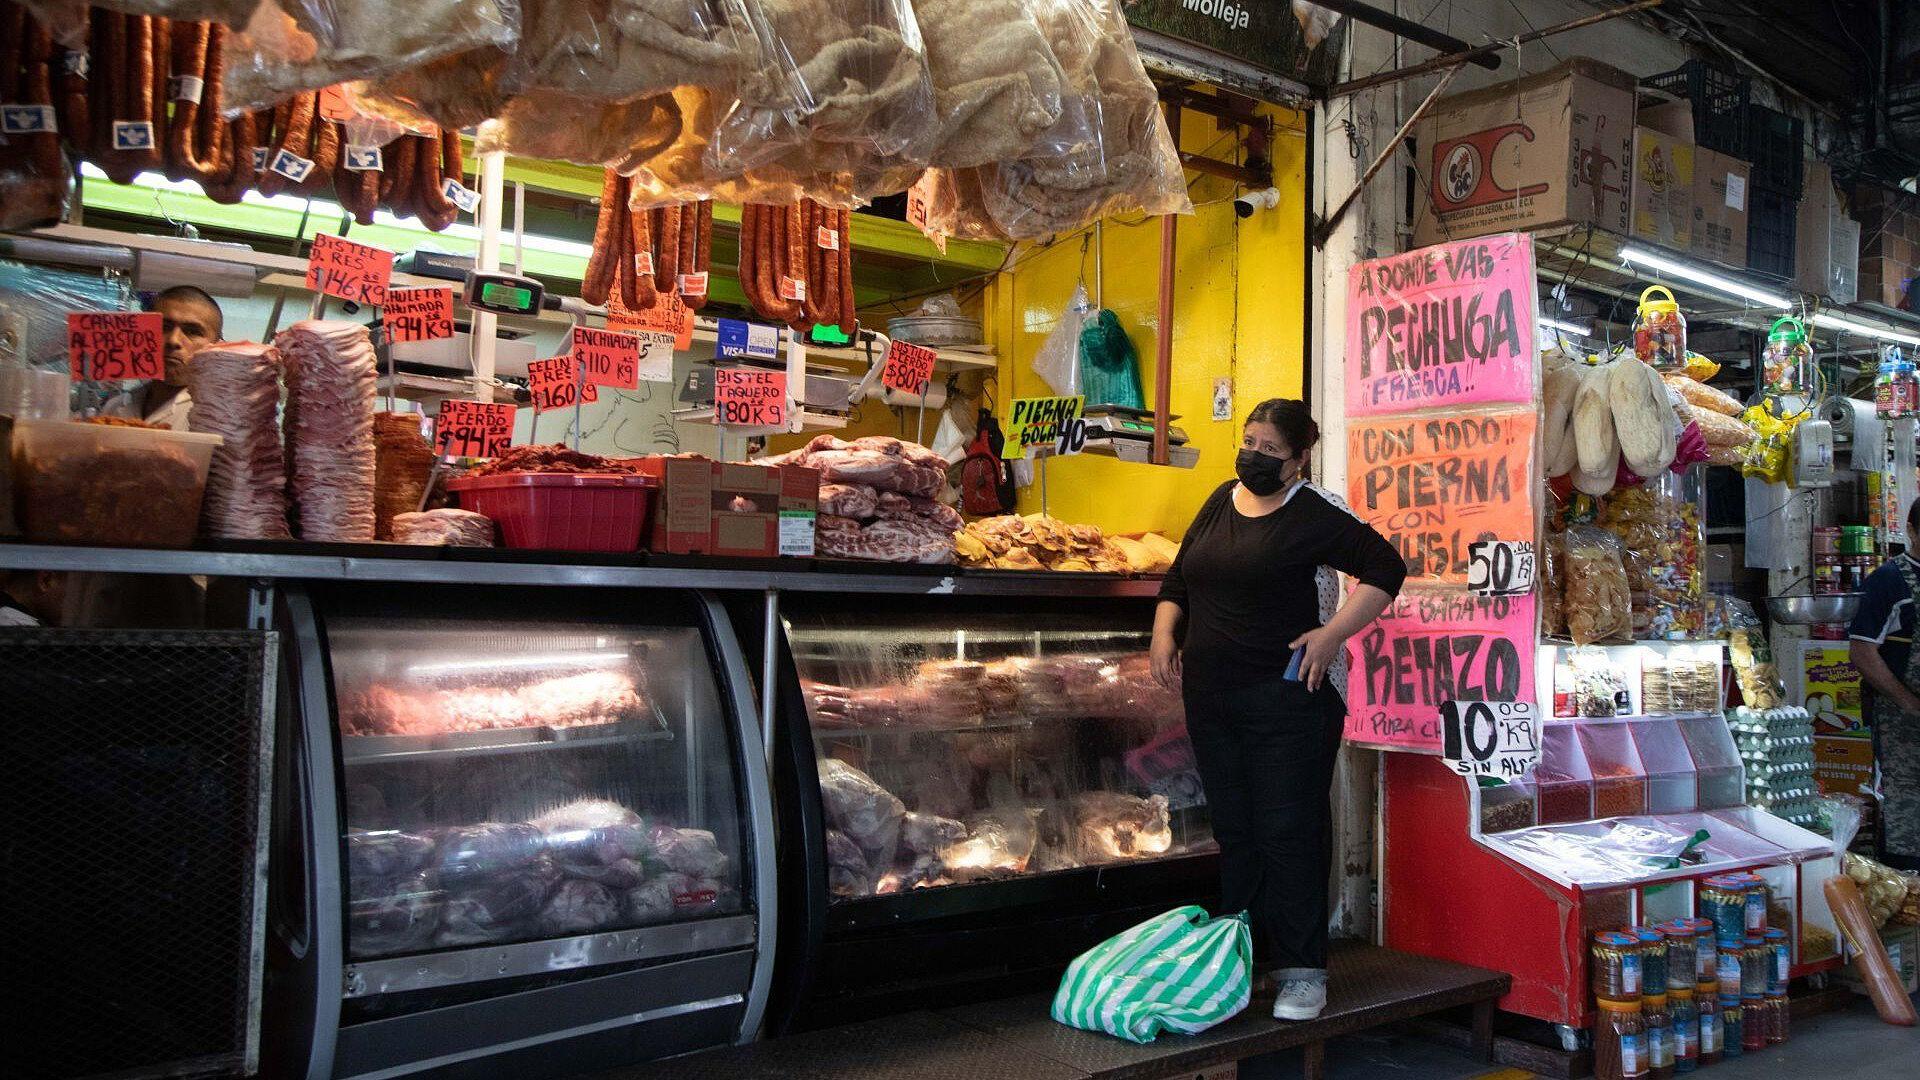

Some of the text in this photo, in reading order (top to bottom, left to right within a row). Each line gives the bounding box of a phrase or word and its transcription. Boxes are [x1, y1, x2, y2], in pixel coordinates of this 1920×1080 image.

[1620, 139, 1631, 229] HUEVOS
[314, 234, 377, 260] BISTEC
[332, 252, 364, 270] RES
[1358, 266, 1375, 298] A
[1377, 252, 1438, 296] DONDE
[386, 288, 443, 302] HULETA
[383, 301, 444, 315] AHUMADA
[80, 314, 139, 330] CARNE
[71, 329, 158, 351] AL PASTOR
[574, 328, 638, 351] ENCHILADA
[1360, 288, 1521, 380] PECHUGA
[722, 345, 745, 356] VISA
[527, 357, 570, 374] CECIN
[886, 363, 916, 388] $80
[543, 368, 572, 384] RES
[716, 369, 774, 385] BISTEC
[716, 385, 780, 400] TAQUERO
[440, 400, 507, 415] BISTEC
[1013, 398, 1078, 425] PIERNA
[456, 413, 506, 427] CERDO
[1057, 418, 1086, 455] 40
[1365, 456, 1511, 509] PIERNA
[1387, 505, 1445, 532] CON
[1362, 627, 1521, 707] RETAZO
[1456, 760, 1492, 775] SIN
